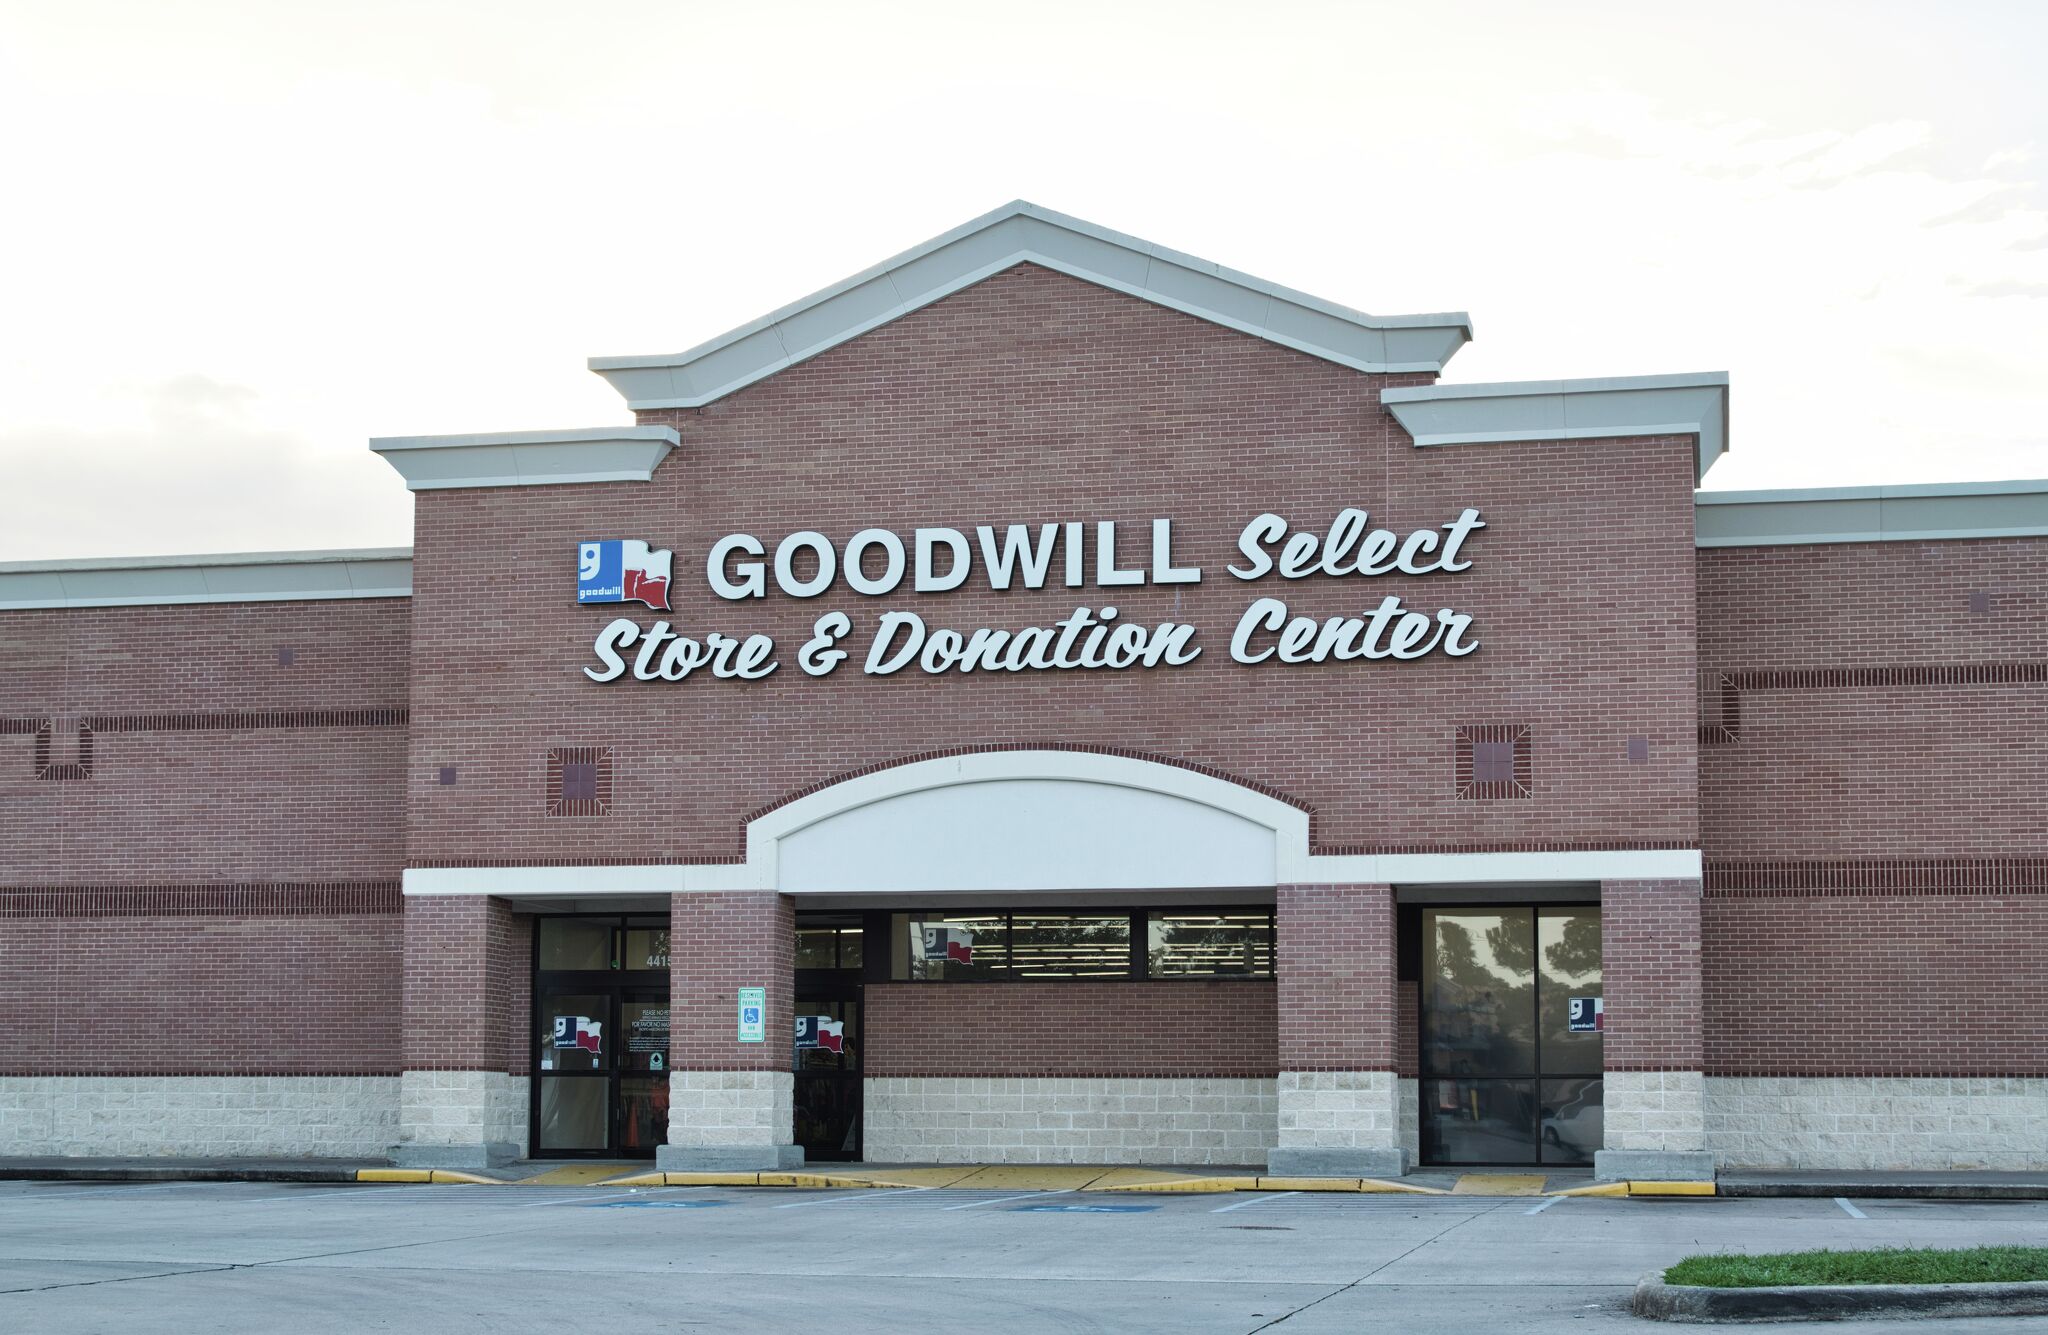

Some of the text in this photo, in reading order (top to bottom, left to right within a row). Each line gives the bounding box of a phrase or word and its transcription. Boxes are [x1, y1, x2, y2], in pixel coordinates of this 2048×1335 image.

[580, 586, 621, 600] goodwill
[707, 508, 1486, 600] GOODWILL Select
[583, 596, 1479, 682] Store & Donation Center
